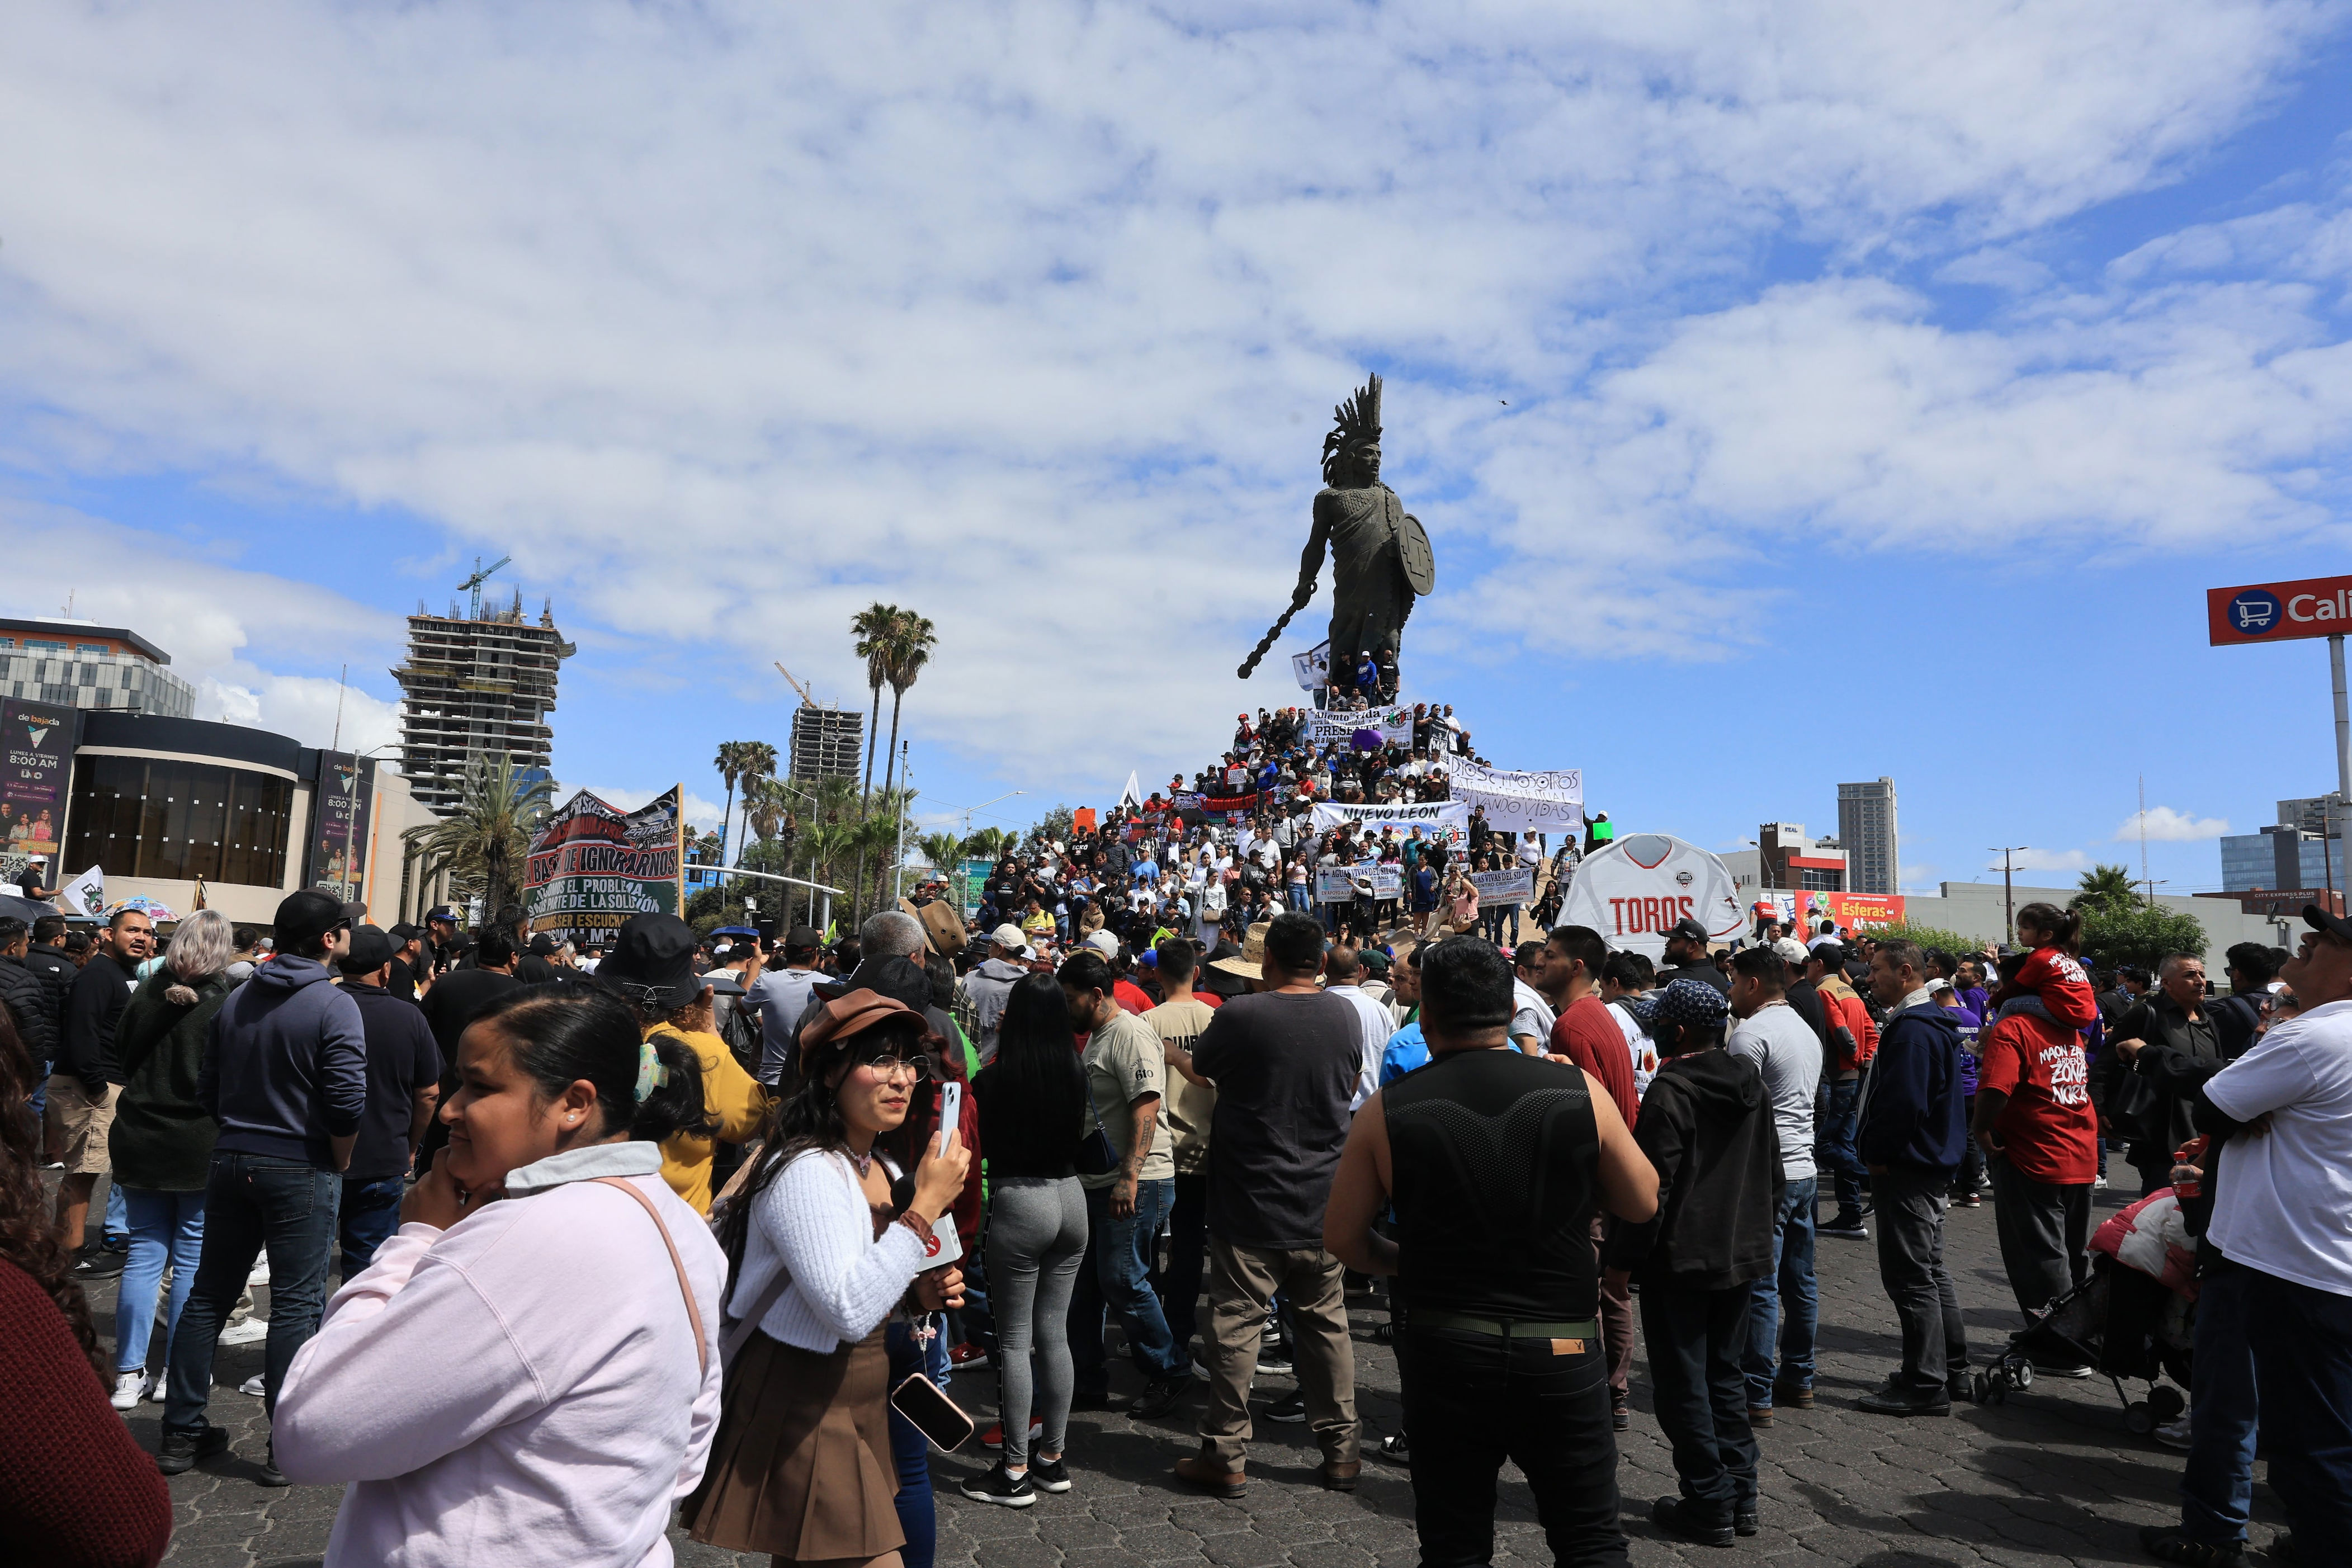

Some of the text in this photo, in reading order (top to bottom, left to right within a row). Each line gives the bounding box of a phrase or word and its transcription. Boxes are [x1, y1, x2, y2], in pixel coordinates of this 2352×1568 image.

[31, 715, 60, 726] bajada
[1315, 712, 1349, 721] Aliento
[10, 755, 58, 769] 8:00 AM
[1509, 771, 1578, 790] NOSOTROS
[328, 799, 347, 808] 8:00
[1343, 805, 1441, 820] NUEVO LEÓN
[564, 848, 577, 873] DE
[1332, 866, 1398, 877] AGUAS VIVAS DEL SILOE
[1485, 873, 1501, 882] VIVAS
[1502, 872, 1514, 881] DEL
[1514, 870, 1530, 879] SILOE
[567, 879, 579, 893] EL
[547, 895, 568, 911] PARTE
[569, 894, 586, 908] DE
[591, 894, 607, 908] LA
[558, 913, 573, 928] SER
[1608, 895, 1694, 937] TOROS
[1627, 1036, 1636, 1046] LA
[2039, 1045, 2067, 1065] MAON
[1130, 1057, 1155, 1071] ANIVERSARIO
[1136, 1069, 1154, 1081] 6to
[2050, 1064, 2087, 1084] ZONA
